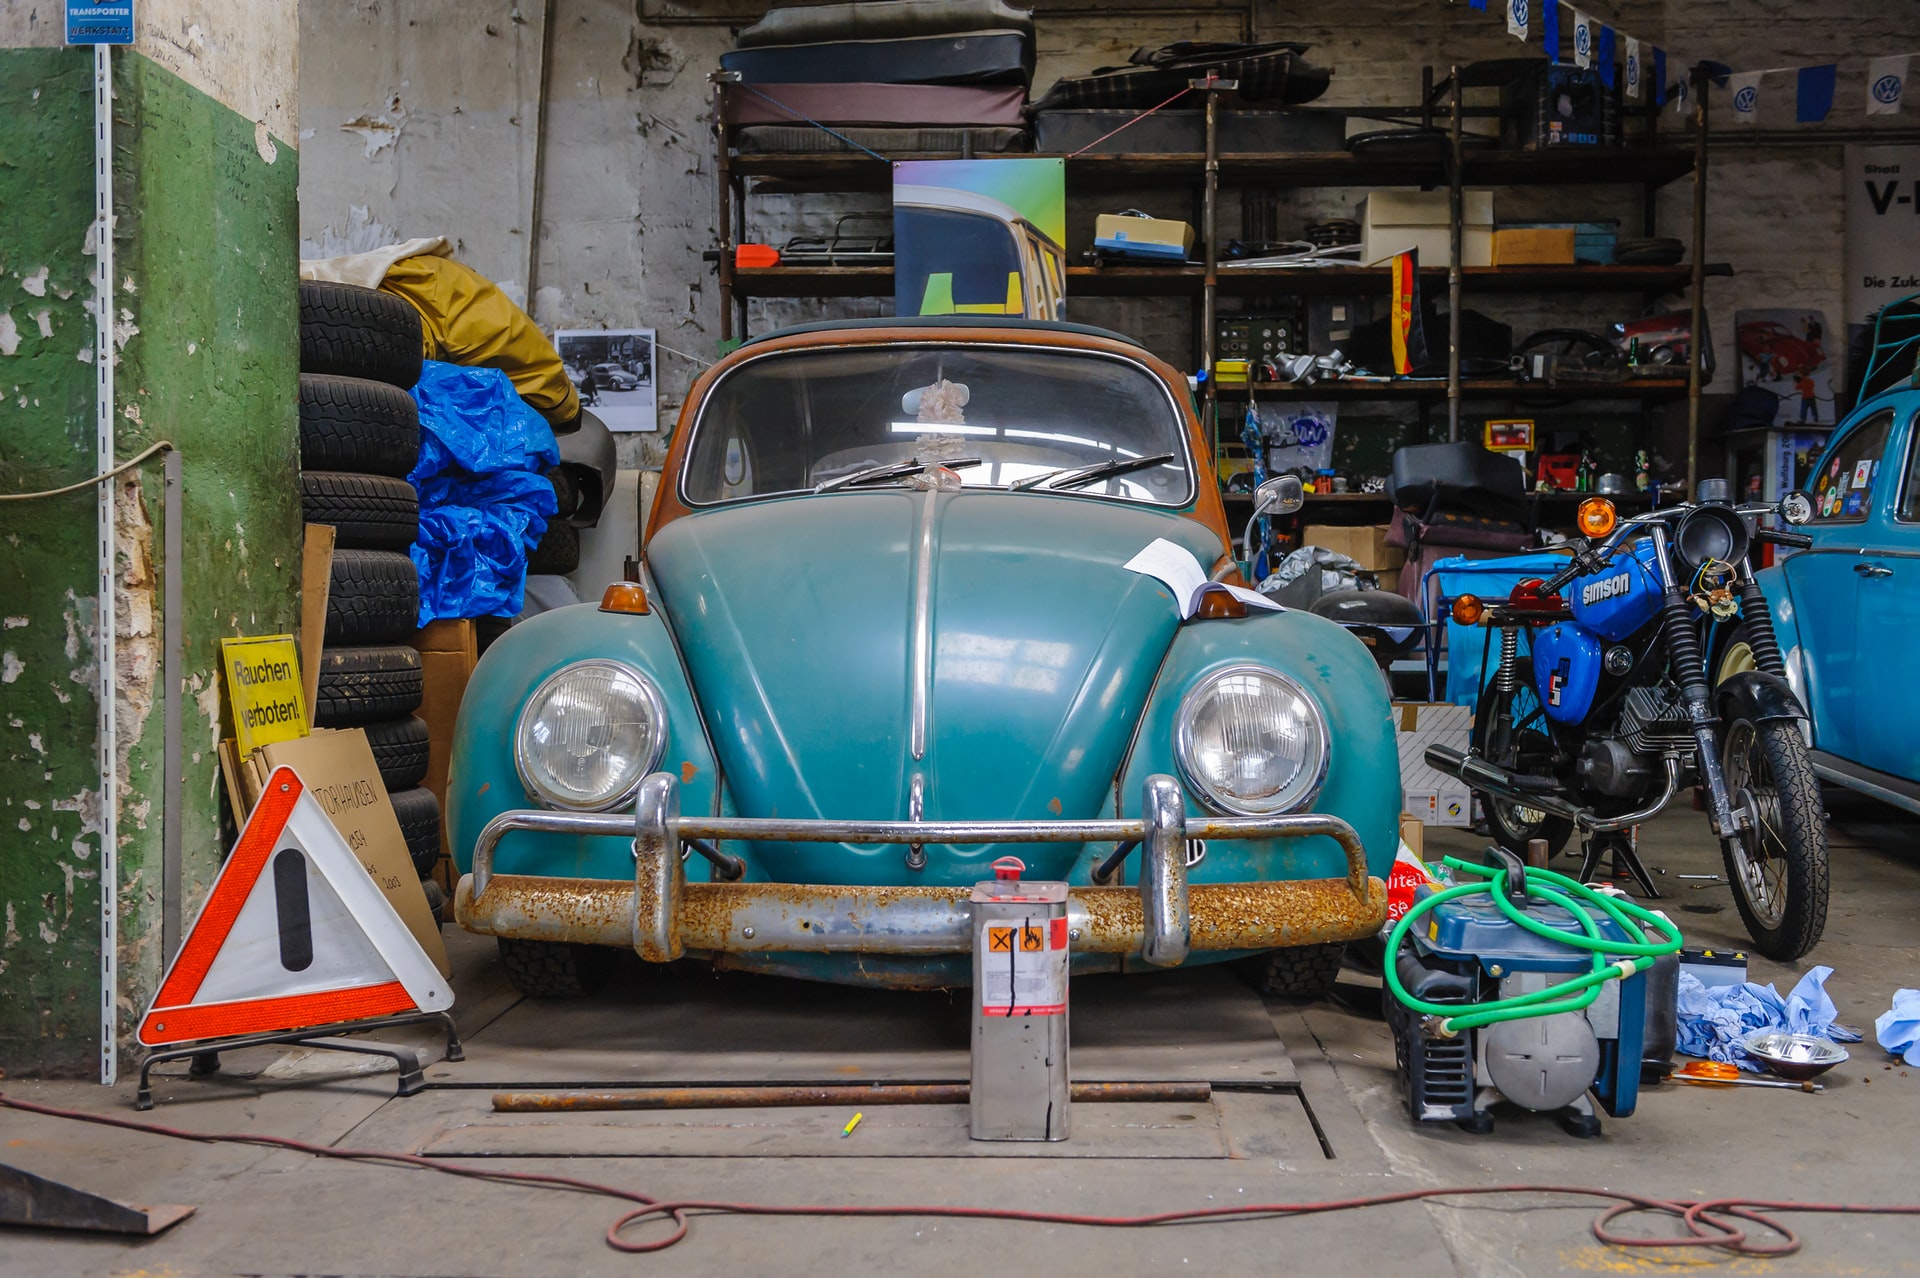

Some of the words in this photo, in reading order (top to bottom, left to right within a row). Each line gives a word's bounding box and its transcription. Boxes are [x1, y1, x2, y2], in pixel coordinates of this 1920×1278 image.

[69, 8, 130, 16] TRANSPORTER
[70, 26, 129, 36] WERKSTATT
[1872, 75, 1902, 104] VW
[1863, 165, 1900, 174] Shell
[1863, 276, 1886, 288] Die
[234, 658, 292, 687] Rauchen
[241, 695, 300, 728] verboten!
